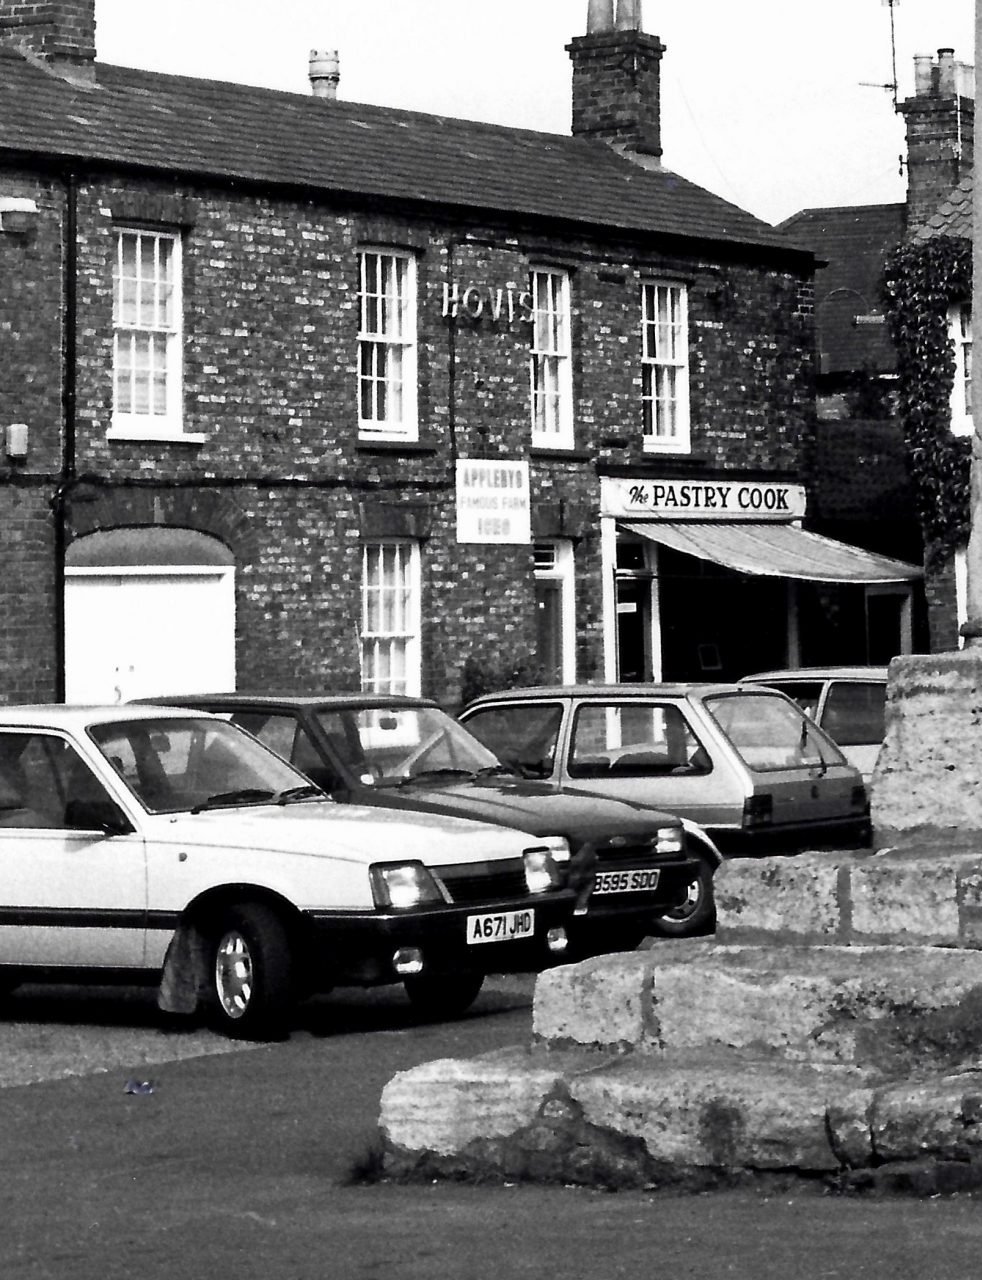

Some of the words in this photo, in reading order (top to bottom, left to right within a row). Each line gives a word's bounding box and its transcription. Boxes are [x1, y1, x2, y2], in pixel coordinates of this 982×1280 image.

[442, 281, 535, 323] HOVIS
[629, 485, 649, 504] The
[653, 485, 731, 508] PASTRY
[738, 487, 789, 510] COOK
[473, 916, 507, 939] A671
[510, 912, 531, 935] JHD
